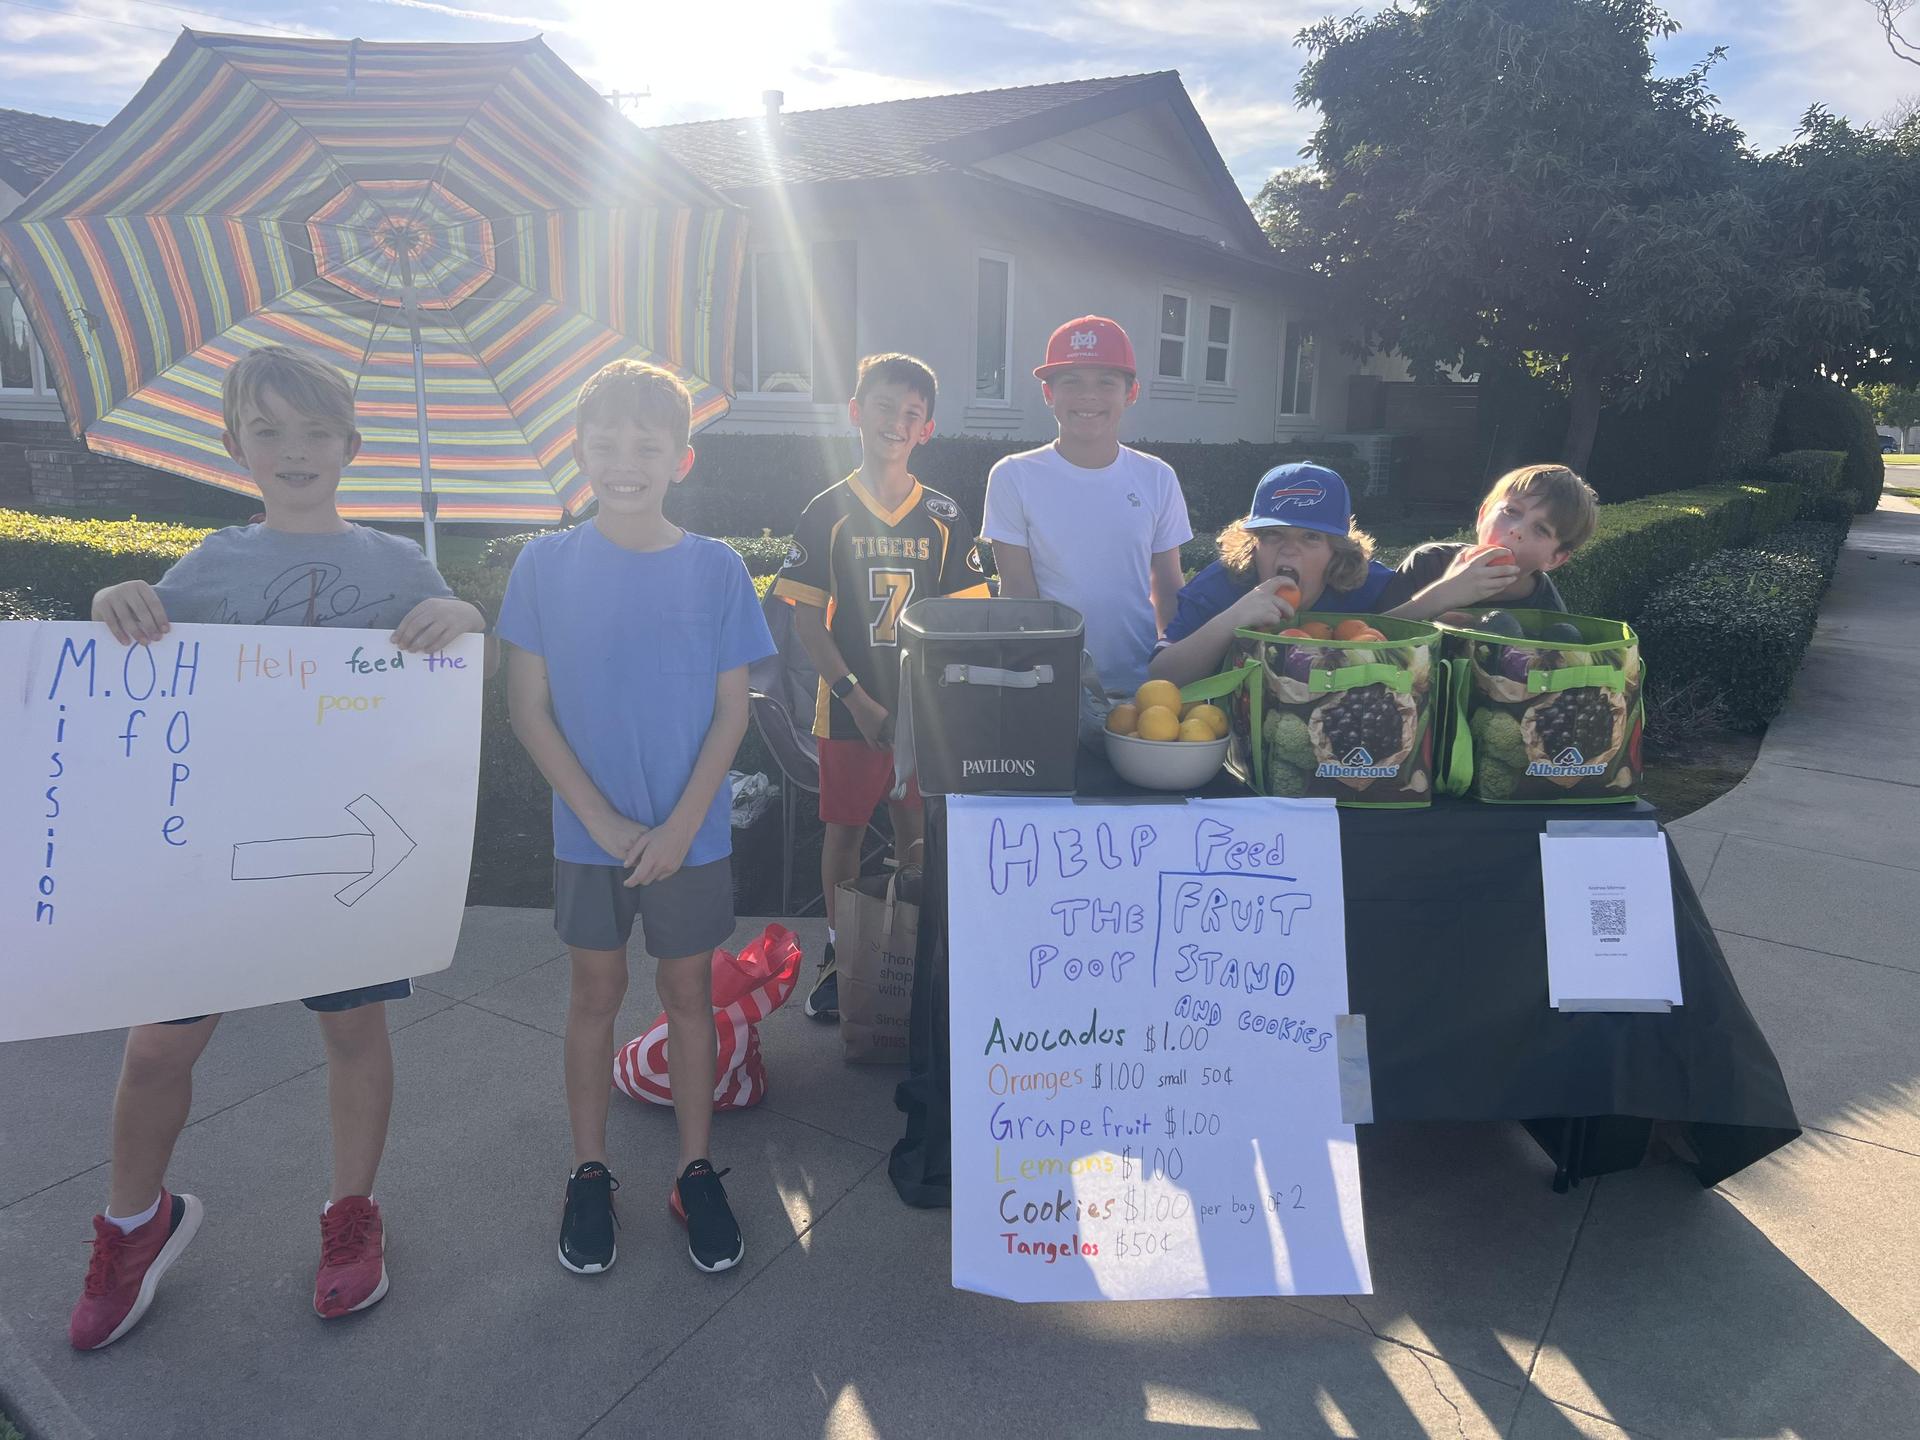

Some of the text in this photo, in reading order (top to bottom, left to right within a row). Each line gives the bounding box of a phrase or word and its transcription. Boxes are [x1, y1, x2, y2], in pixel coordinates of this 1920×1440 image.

[851, 536, 930, 560] TIGERS
[868, 567, 915, 647] 7
[237, 643, 468, 690] Help feed the
[316, 694, 386, 726] poor
[962, 759, 1036, 778] PAVILIONS
[1315, 761, 1399, 779] Albertsons
[1525, 760, 1608, 778] Albertsons
[989, 817, 1285, 895] HELP Feed
[1051, 897, 1145, 937] THE
[1175, 943, 1295, 997] STAND
[1174, 994, 1223, 1027] AND
[984, 1007, 1210, 1056] Avocados $1.00
[988, 1063, 1083, 1101] Oranges
[1158, 1067, 1188, 1089] small
[1200, 1065, 1234, 1087] 50¢
[1164, 1106, 1221, 1140] $1.00
[995, 1147, 1115, 1186] Lemons
[1000, 1189, 1116, 1224] Cookies
[1200, 1203, 1222, 1225] per
[1232, 1194, 1256, 1225] bag
[1291, 1184, 1306, 1210] 2
[1000, 1229, 1173, 1264] Tangelos $50¢
